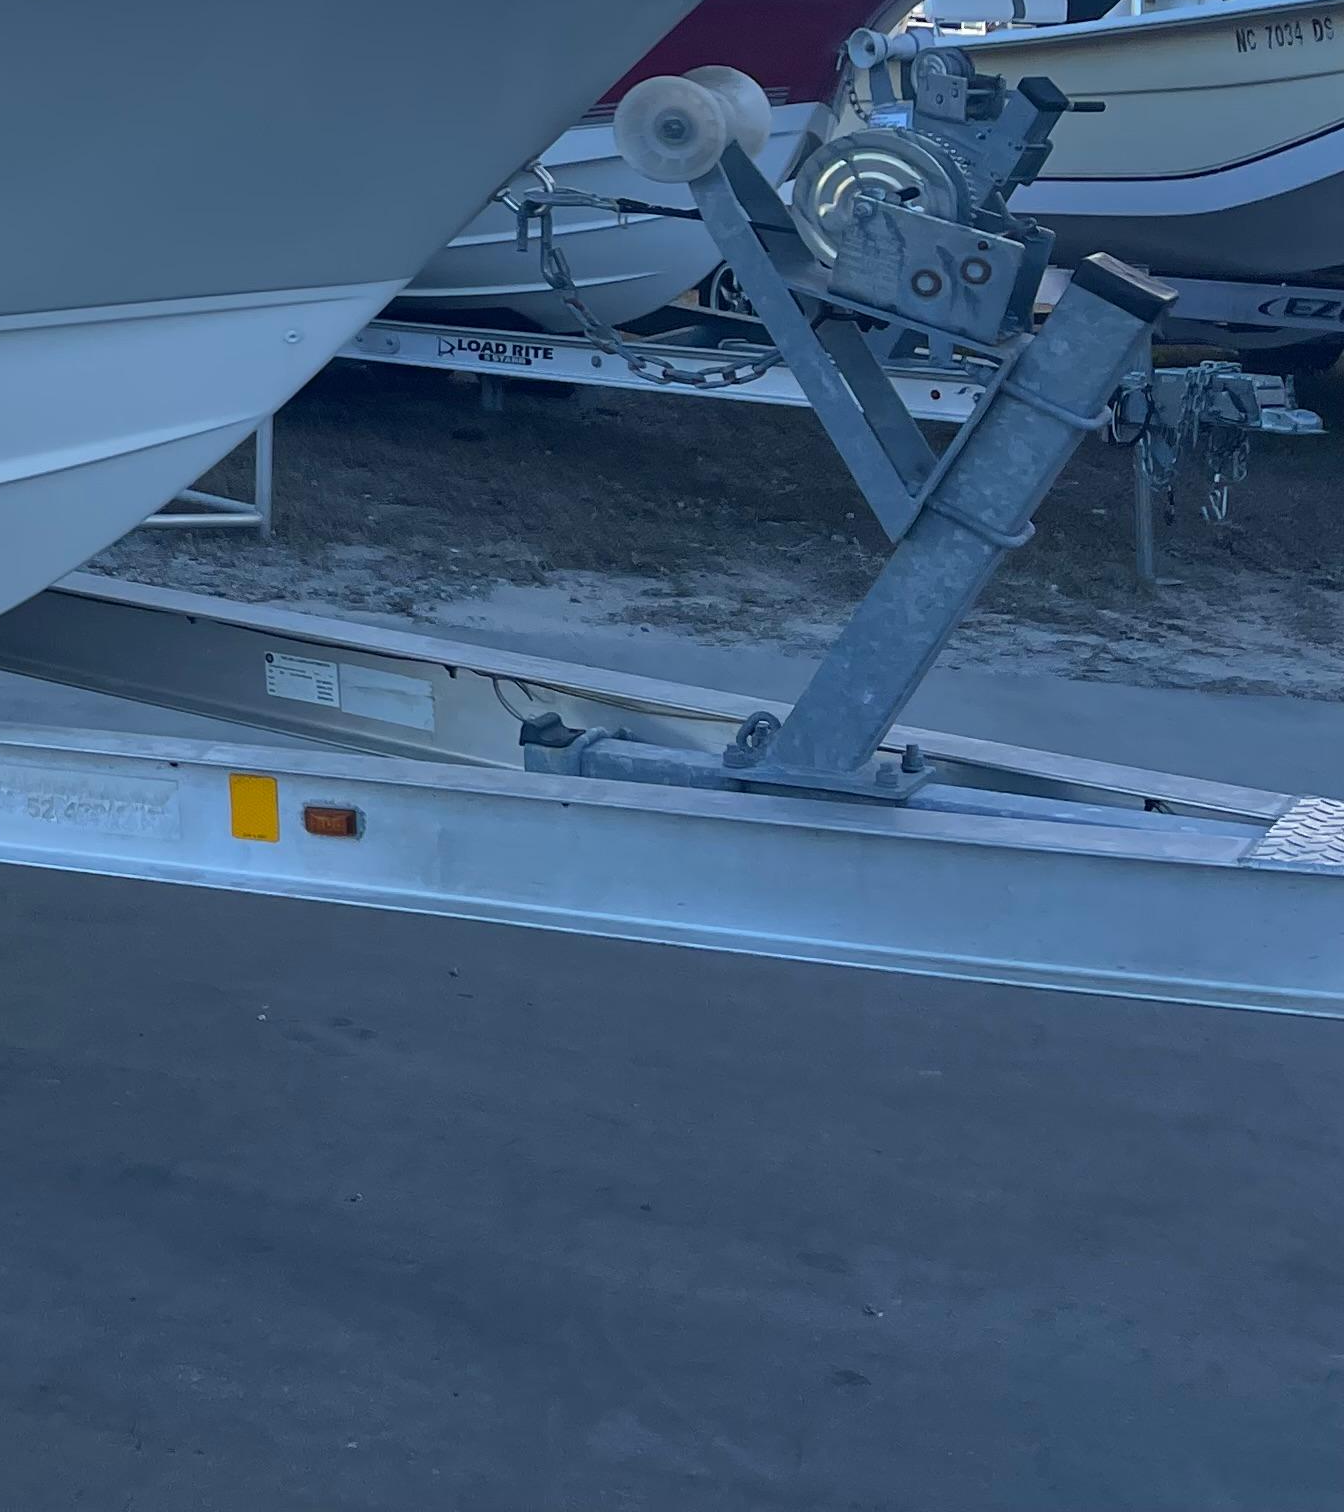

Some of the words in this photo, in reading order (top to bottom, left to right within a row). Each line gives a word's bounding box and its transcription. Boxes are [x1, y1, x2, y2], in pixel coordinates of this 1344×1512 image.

[1235, 28, 1256, 53] NC
[1265, 20, 1303, 49] 7034
[1312, 16, 1334, 42] DS
[457, 339, 507, 355] LOAD
[512, 344, 554, 360] RITE
